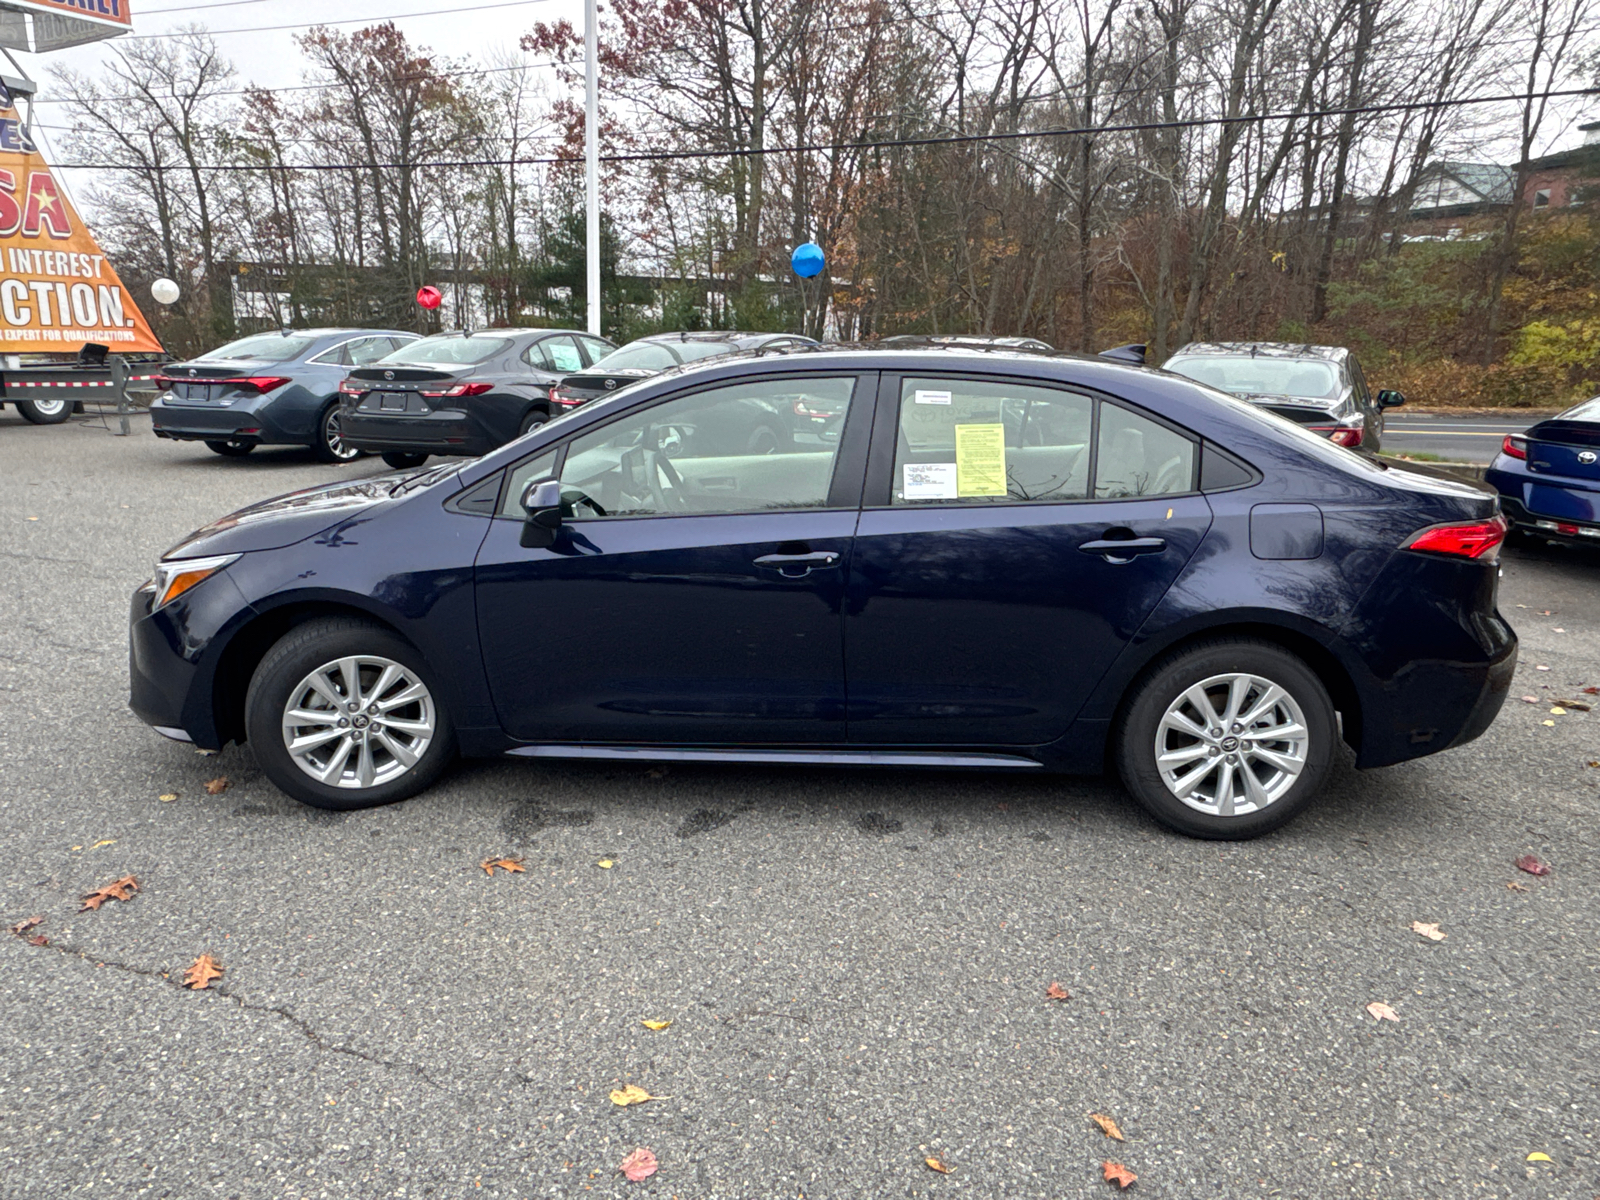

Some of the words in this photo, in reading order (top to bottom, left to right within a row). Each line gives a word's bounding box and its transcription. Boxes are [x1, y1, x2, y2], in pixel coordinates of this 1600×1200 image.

[9, 248, 103, 278] INTEREST
[4, 329, 41, 341] EXPERT
[41, 330, 61, 341] FOR
[62, 330, 136, 343] QUALIFICATIONS
